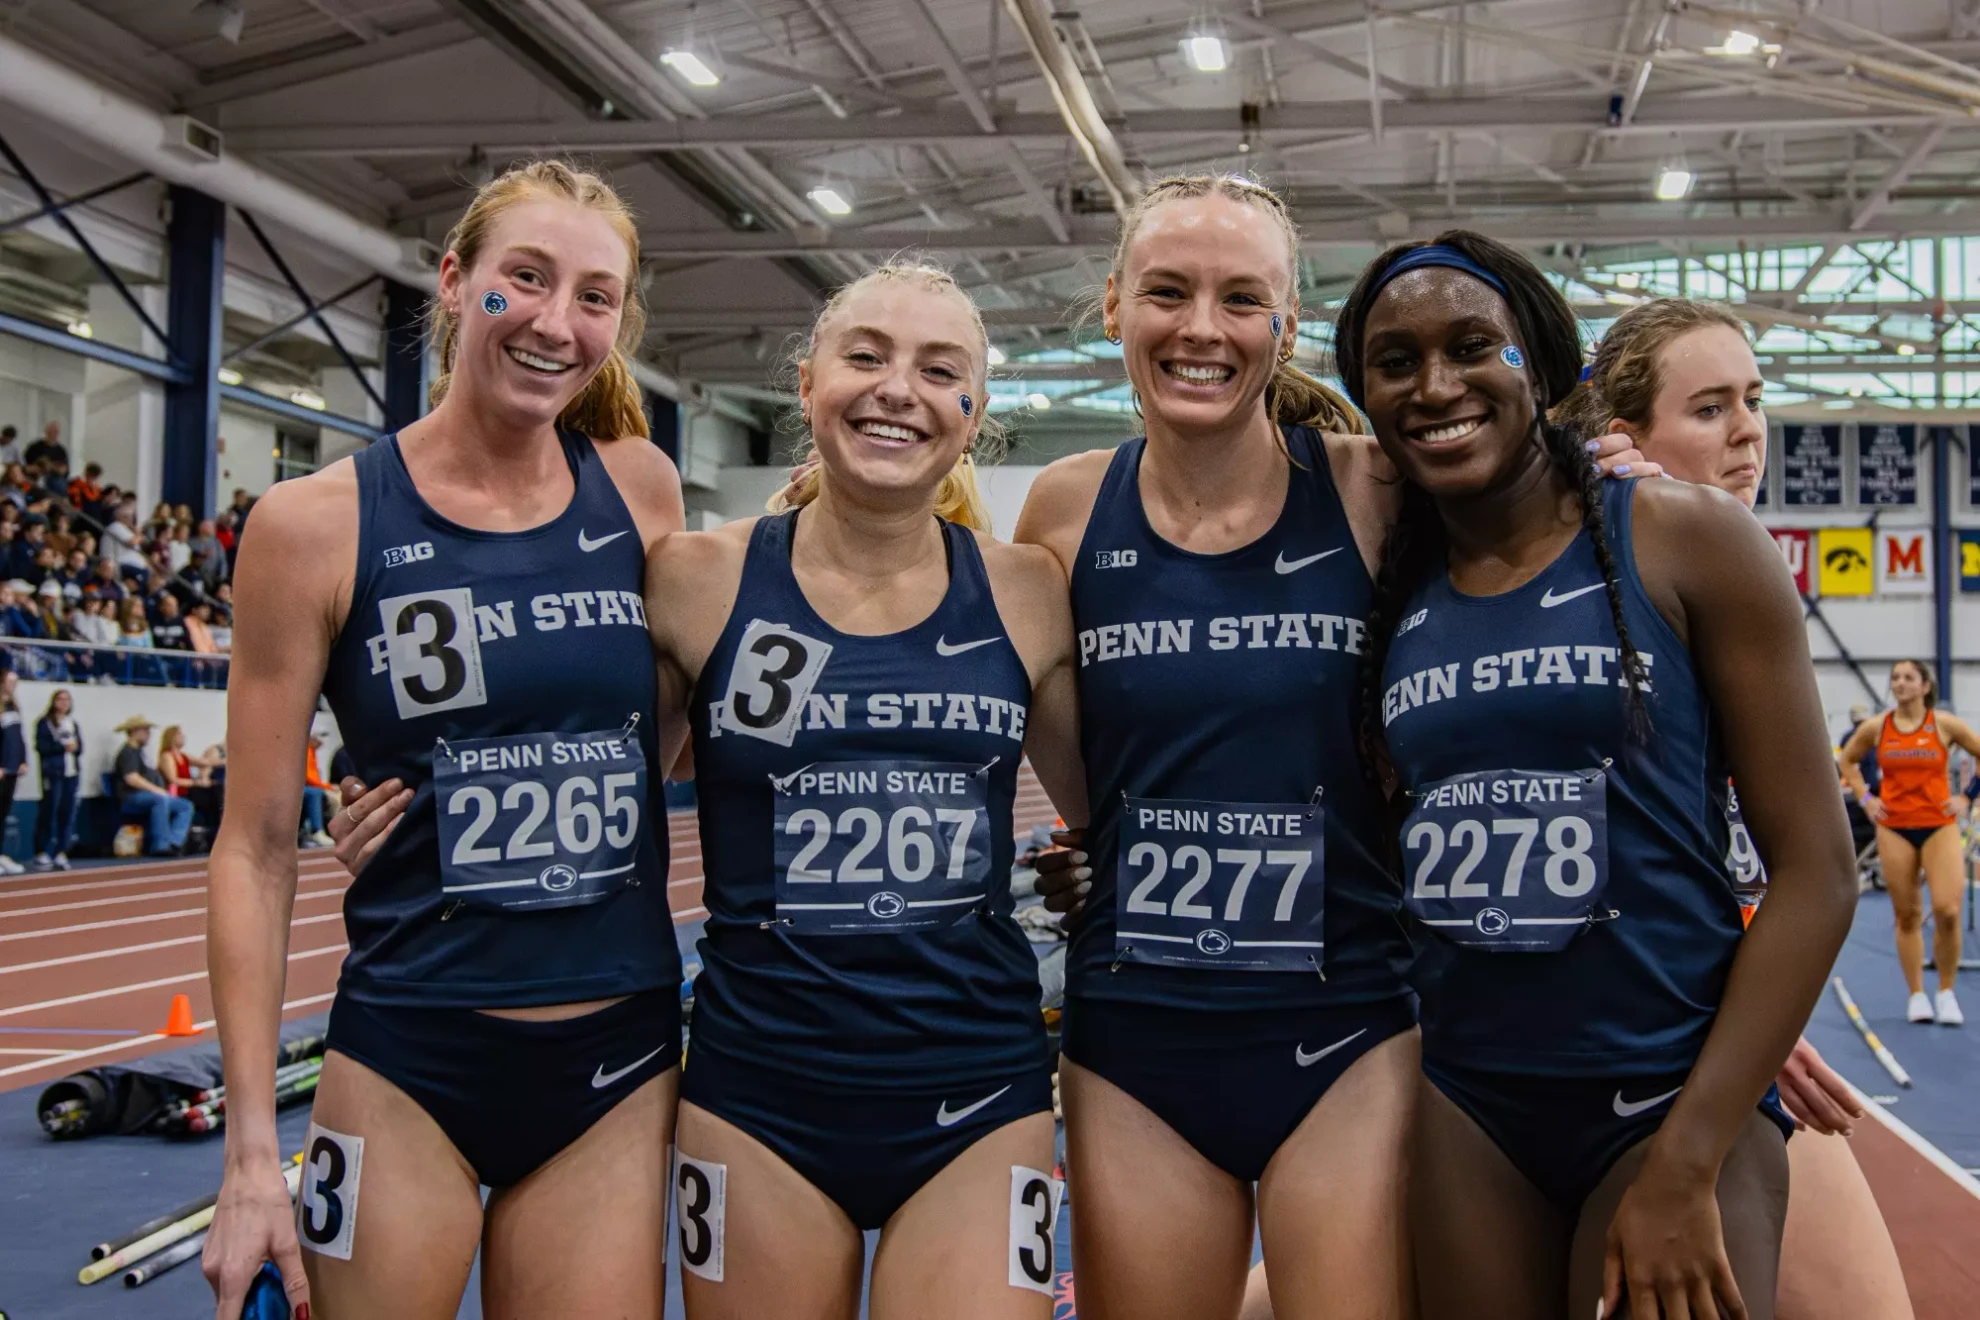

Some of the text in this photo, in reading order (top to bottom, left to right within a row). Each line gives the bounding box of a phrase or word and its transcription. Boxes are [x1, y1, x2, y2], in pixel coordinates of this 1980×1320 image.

[1886, 535, 1925, 575] M
[530, 590, 649, 632] STAT
[1079, 613, 1367, 668] PENN STATE
[396, 599, 467, 705] 3
[733, 633, 808, 729] 3
[867, 693, 1027, 743] STATE
[1382, 662, 1460, 728] ENN
[460, 740, 627, 773] PENN STATE
[800, 771, 966, 795] PENN STATE
[447, 772, 639, 865] 2265
[1139, 808, 1302, 836] PENN STATE
[1423, 778, 1582, 809] PENN STATE
[785, 806, 977, 884] 2267
[1126, 841, 1312, 921] 2277
[1406, 815, 1597, 898] 2278
[302, 1136, 346, 1245] 3
[679, 1162, 712, 1266] 3
[1018, 1178, 1053, 1285] 3
